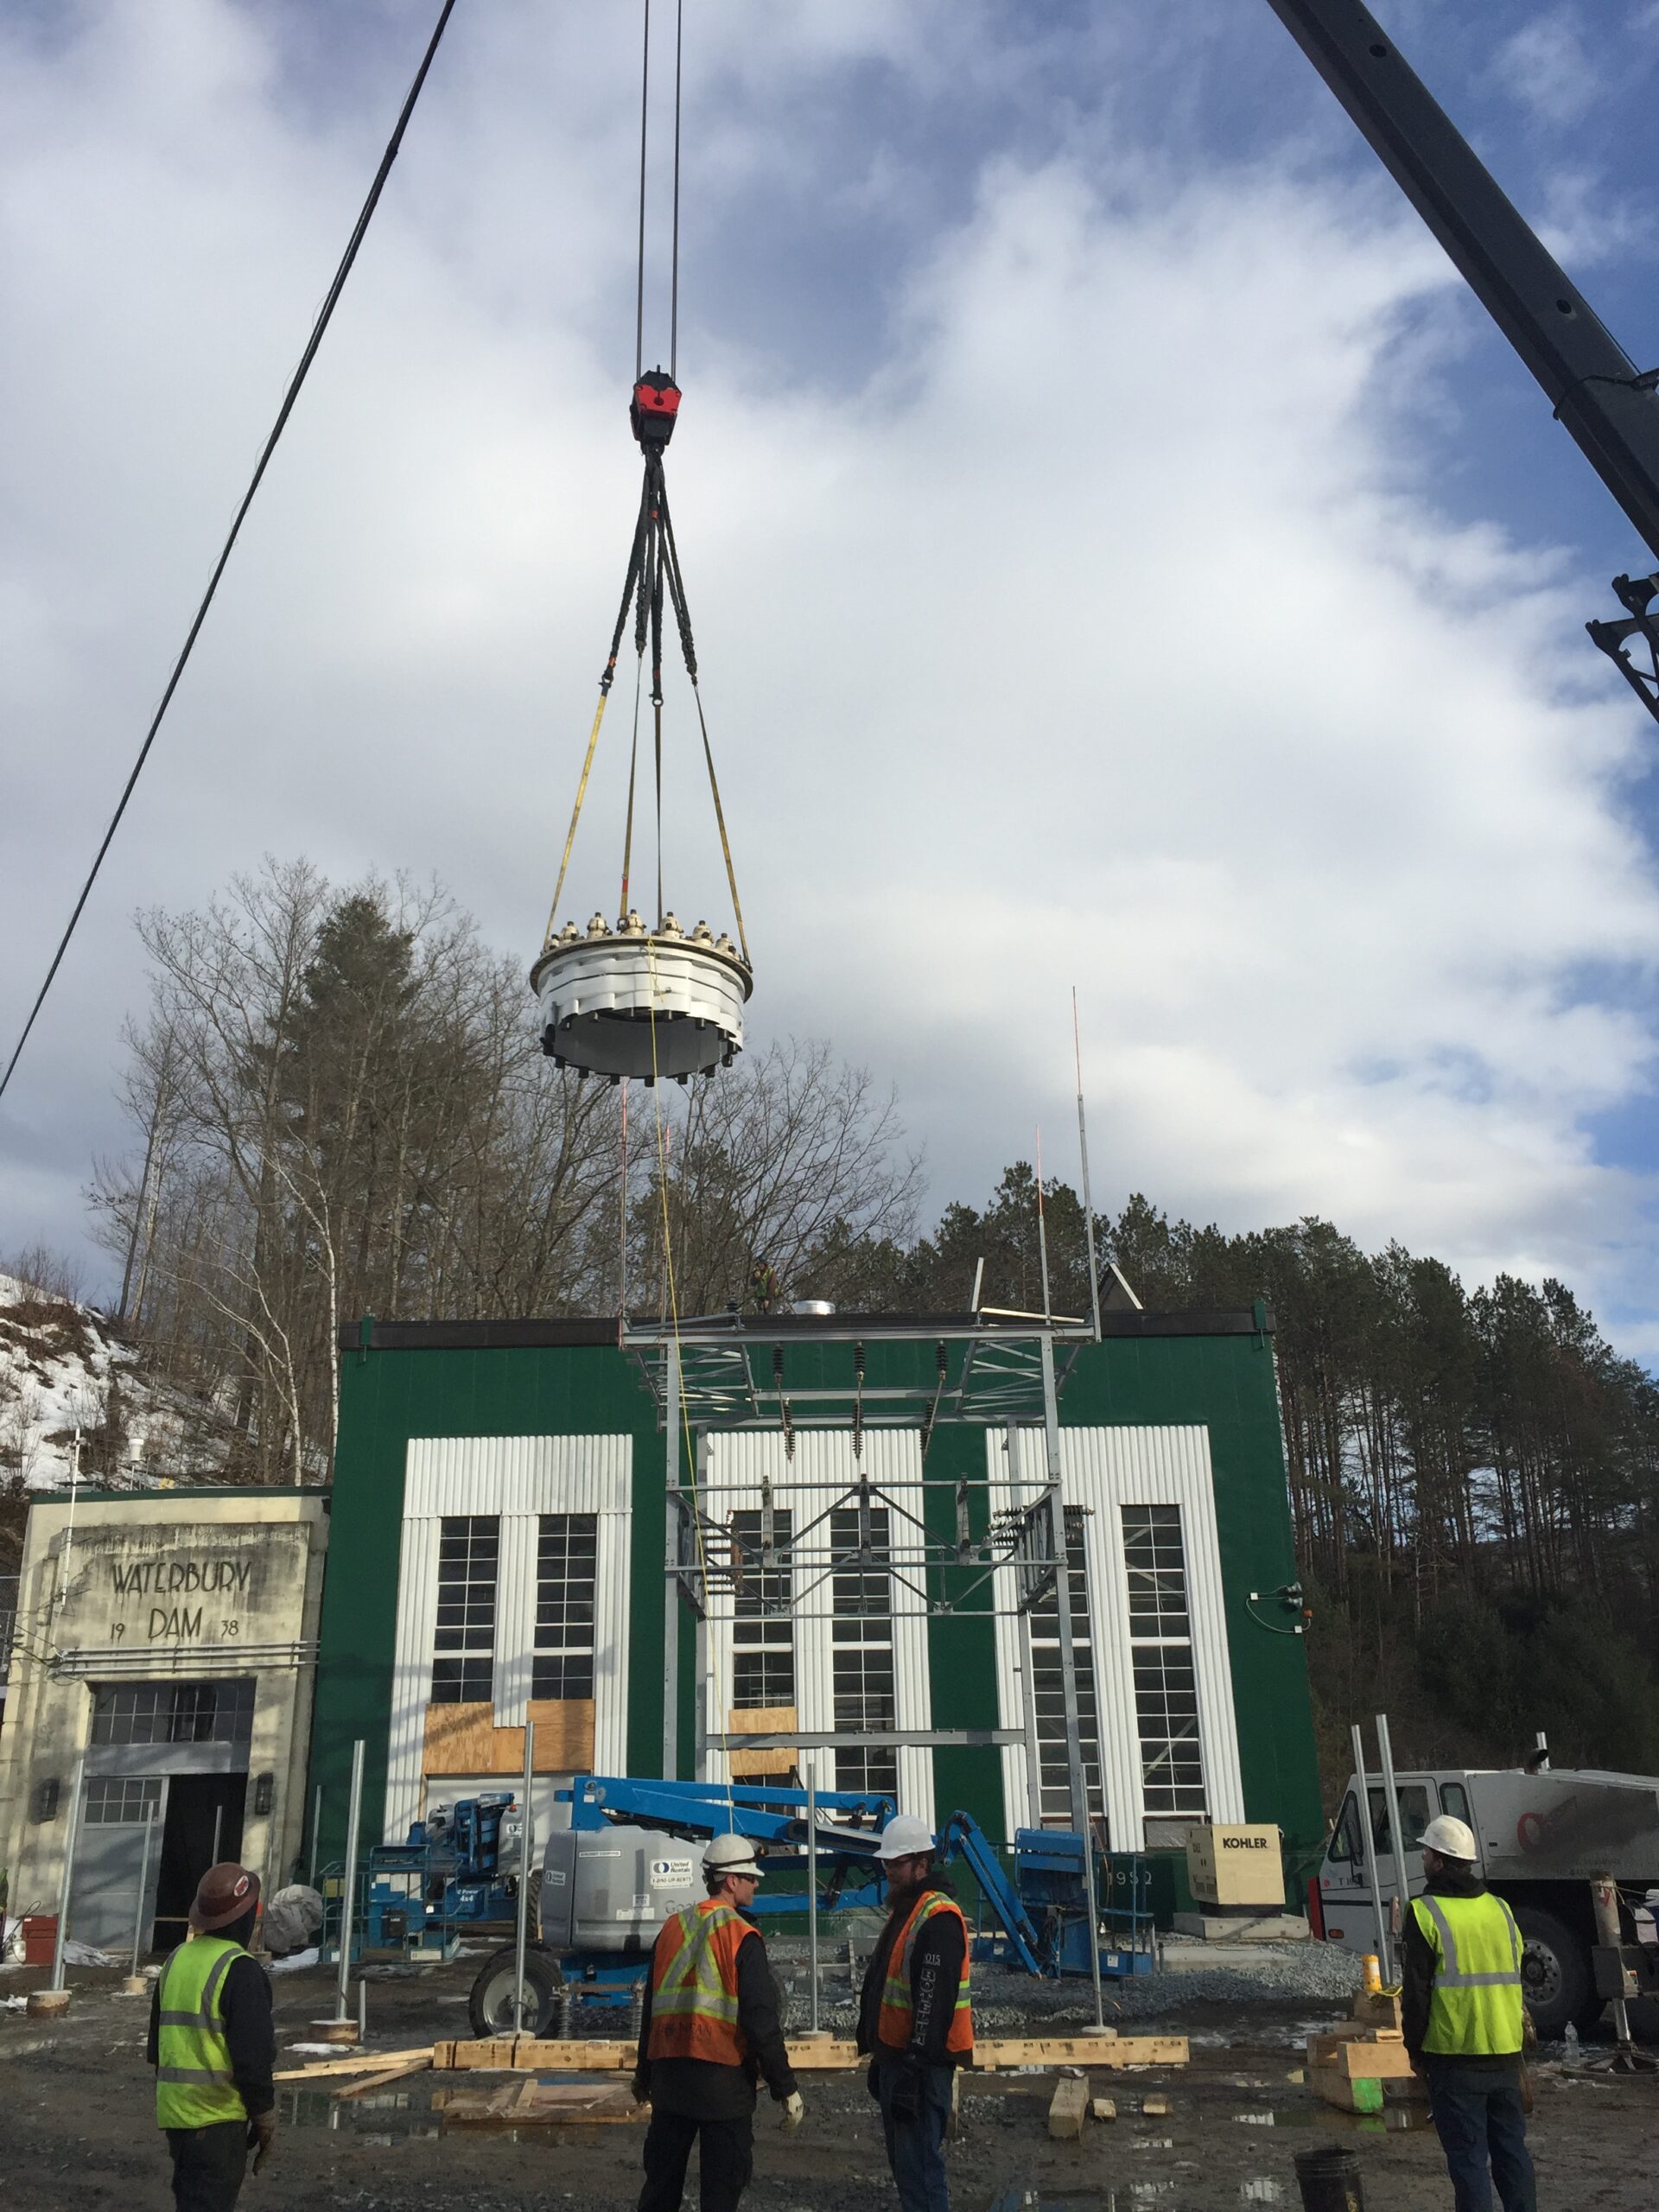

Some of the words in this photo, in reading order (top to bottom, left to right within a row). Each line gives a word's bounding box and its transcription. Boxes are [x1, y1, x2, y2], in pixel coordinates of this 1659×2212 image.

[112, 1561, 251, 1593] WATERBURY
[111, 1624, 124, 1639] 19
[148, 1607, 202, 1638] DAM
[221, 1620, 238, 1636] 38
[1223, 1838, 1268, 1848] KOHLER
